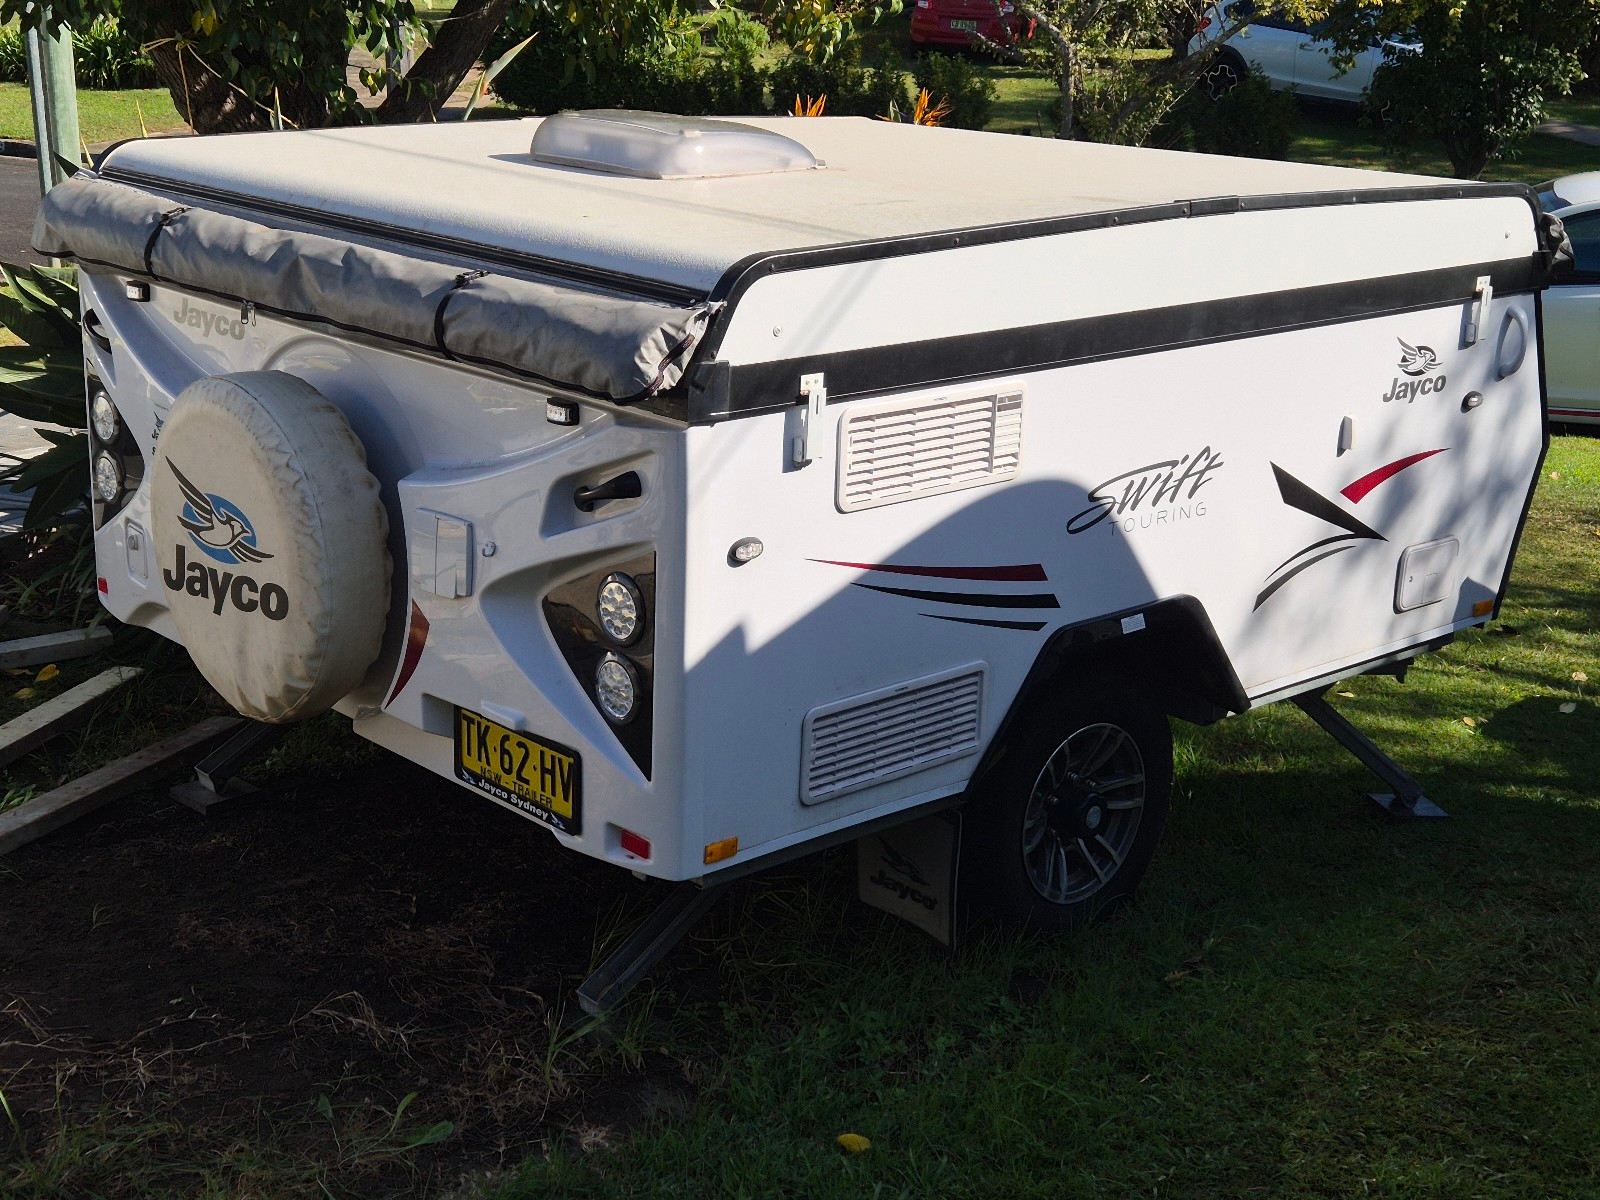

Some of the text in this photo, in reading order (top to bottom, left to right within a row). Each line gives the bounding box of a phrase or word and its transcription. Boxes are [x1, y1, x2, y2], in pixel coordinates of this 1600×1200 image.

[173, 298, 246, 340] Jayco
[1382, 374, 1447, 403] Jayco
[1066, 445, 1224, 535] Swift
[1108, 501, 1208, 536] TOURING
[162, 544, 290, 621] Jayco
[478, 778, 549, 821] Jayco Sydney
[512, 780, 553, 809] TRAILER
[870, 869, 938, 910] Jayco
